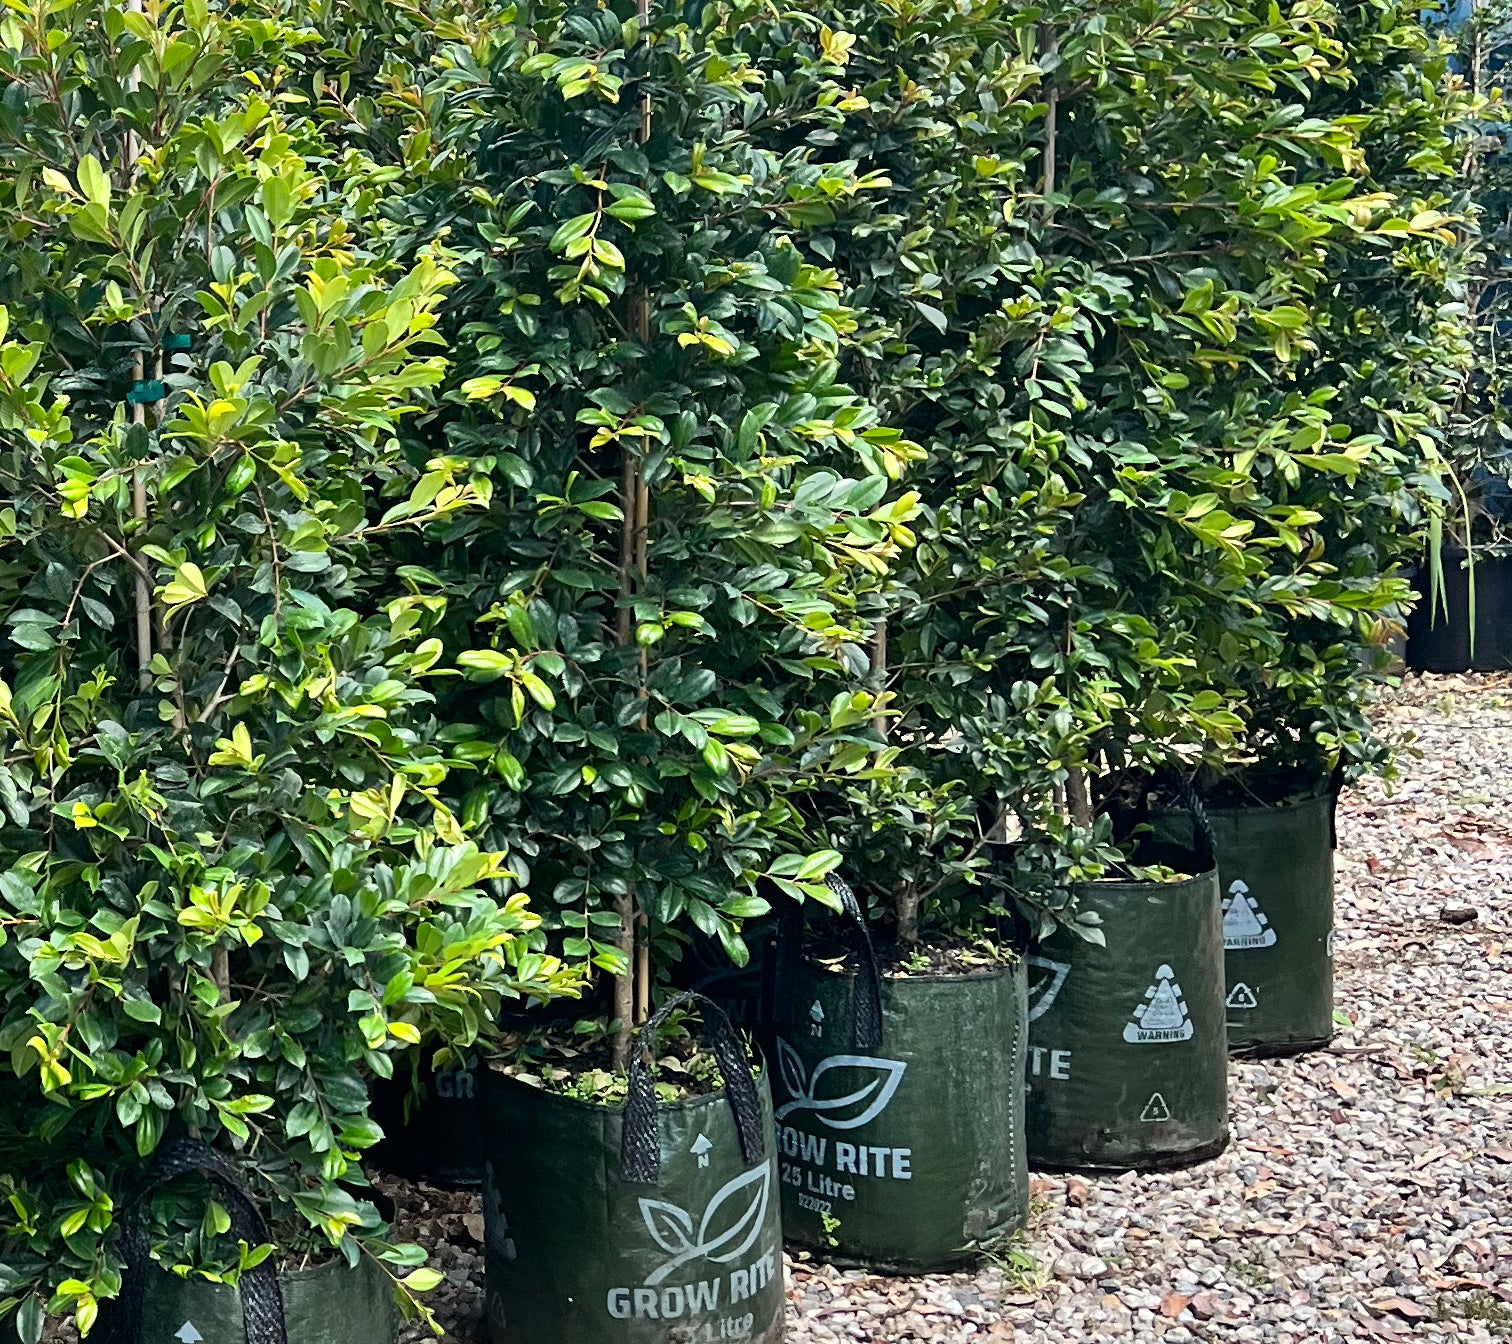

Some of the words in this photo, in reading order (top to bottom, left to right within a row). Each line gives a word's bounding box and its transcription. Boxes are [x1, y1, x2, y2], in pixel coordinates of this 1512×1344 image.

[1224, 936, 1266, 946] ARNING
[1137, 1030, 1185, 1041] WARNING
[1028, 1046, 1071, 1080] TE
[835, 1141, 912, 1180] RITE
[781, 1162, 802, 1187] 25
[807, 1170, 855, 1201] Litre
[606, 1277, 721, 1319] GROW
